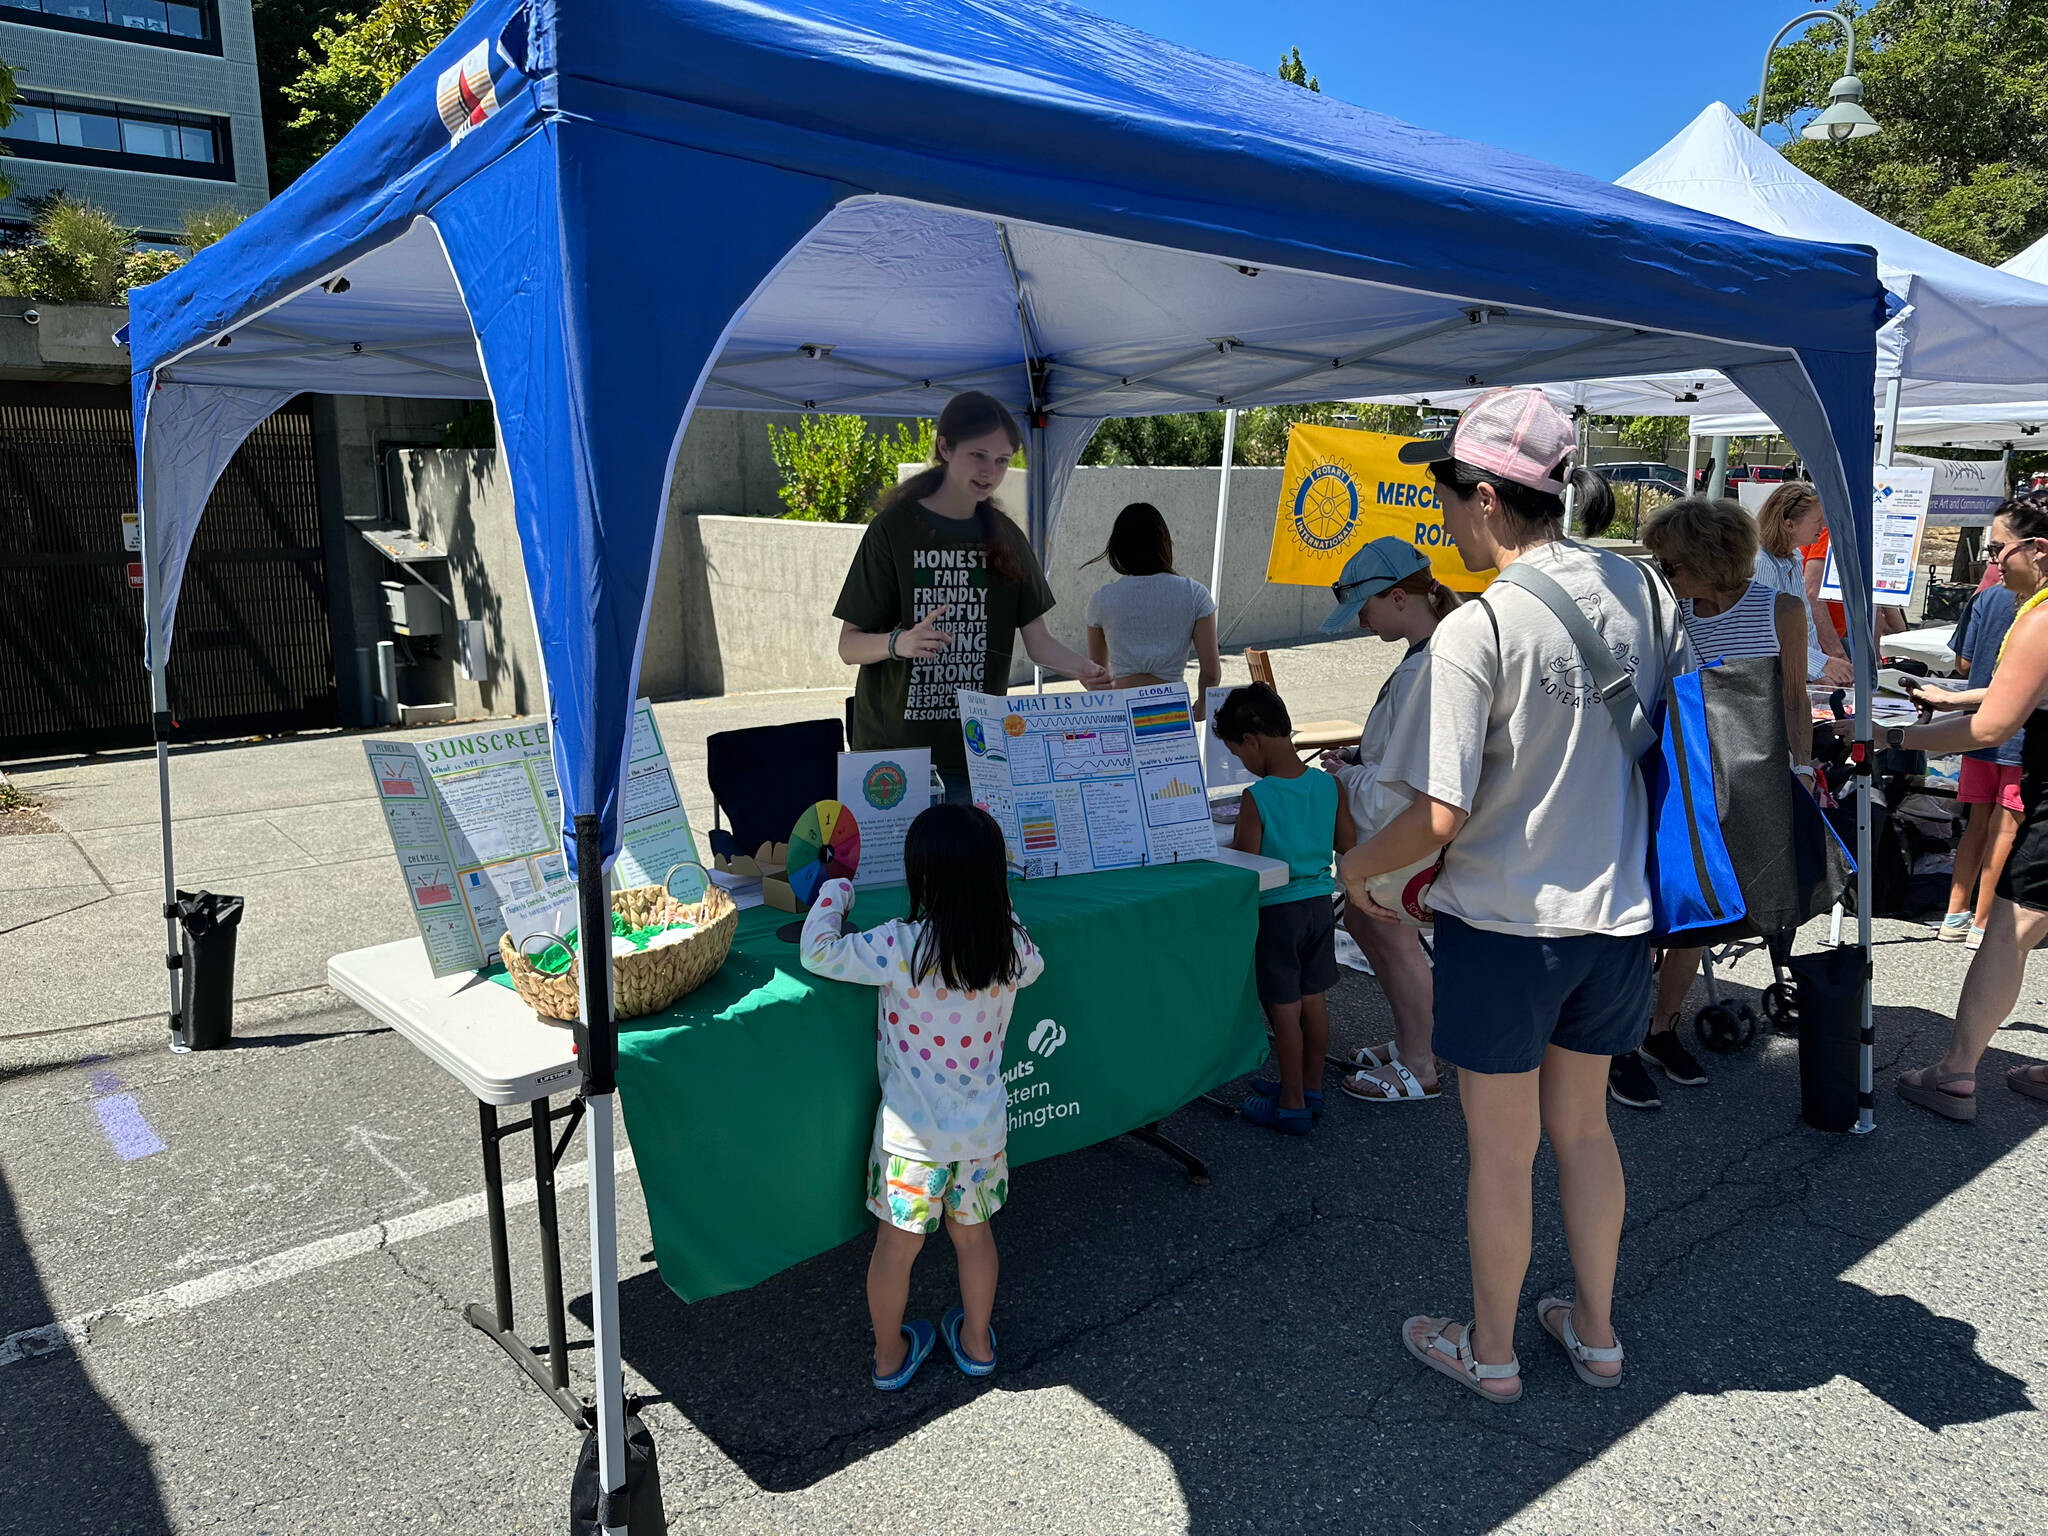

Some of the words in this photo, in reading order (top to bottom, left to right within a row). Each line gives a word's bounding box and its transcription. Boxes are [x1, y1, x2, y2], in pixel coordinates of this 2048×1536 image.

[1316, 466, 1346, 480] ROTARY
[1949, 498, 1960, 510] and
[1296, 520, 1352, 548] INTERNATIONAL
[913, 550, 988, 569] HONEST
[934, 570, 969, 586] FAIR
[913, 587, 988, 604] FRIENDLY
[932, 621, 987, 633] NSIDERATE
[938, 633, 987, 652] ING
[912, 652, 986, 666] COURAGEOUS
[910, 664, 985, 684] STRONG
[908, 682, 984, 696] RESPONSIBLE
[1139, 686, 1174, 697] GLOBAL
[1007, 697, 1048, 713] WHAT
[1053, 697, 1072, 710] IS
[1080, 695, 1113, 708] UV?
[425, 727, 549, 763] SUNSCREE
[430, 764, 450, 775] What
[825, 813, 832, 825] 1
[407, 853, 441, 864] CHEMICAL
[1006, 1081, 1050, 1108] stern
[1008, 1101, 1080, 1132] hington
